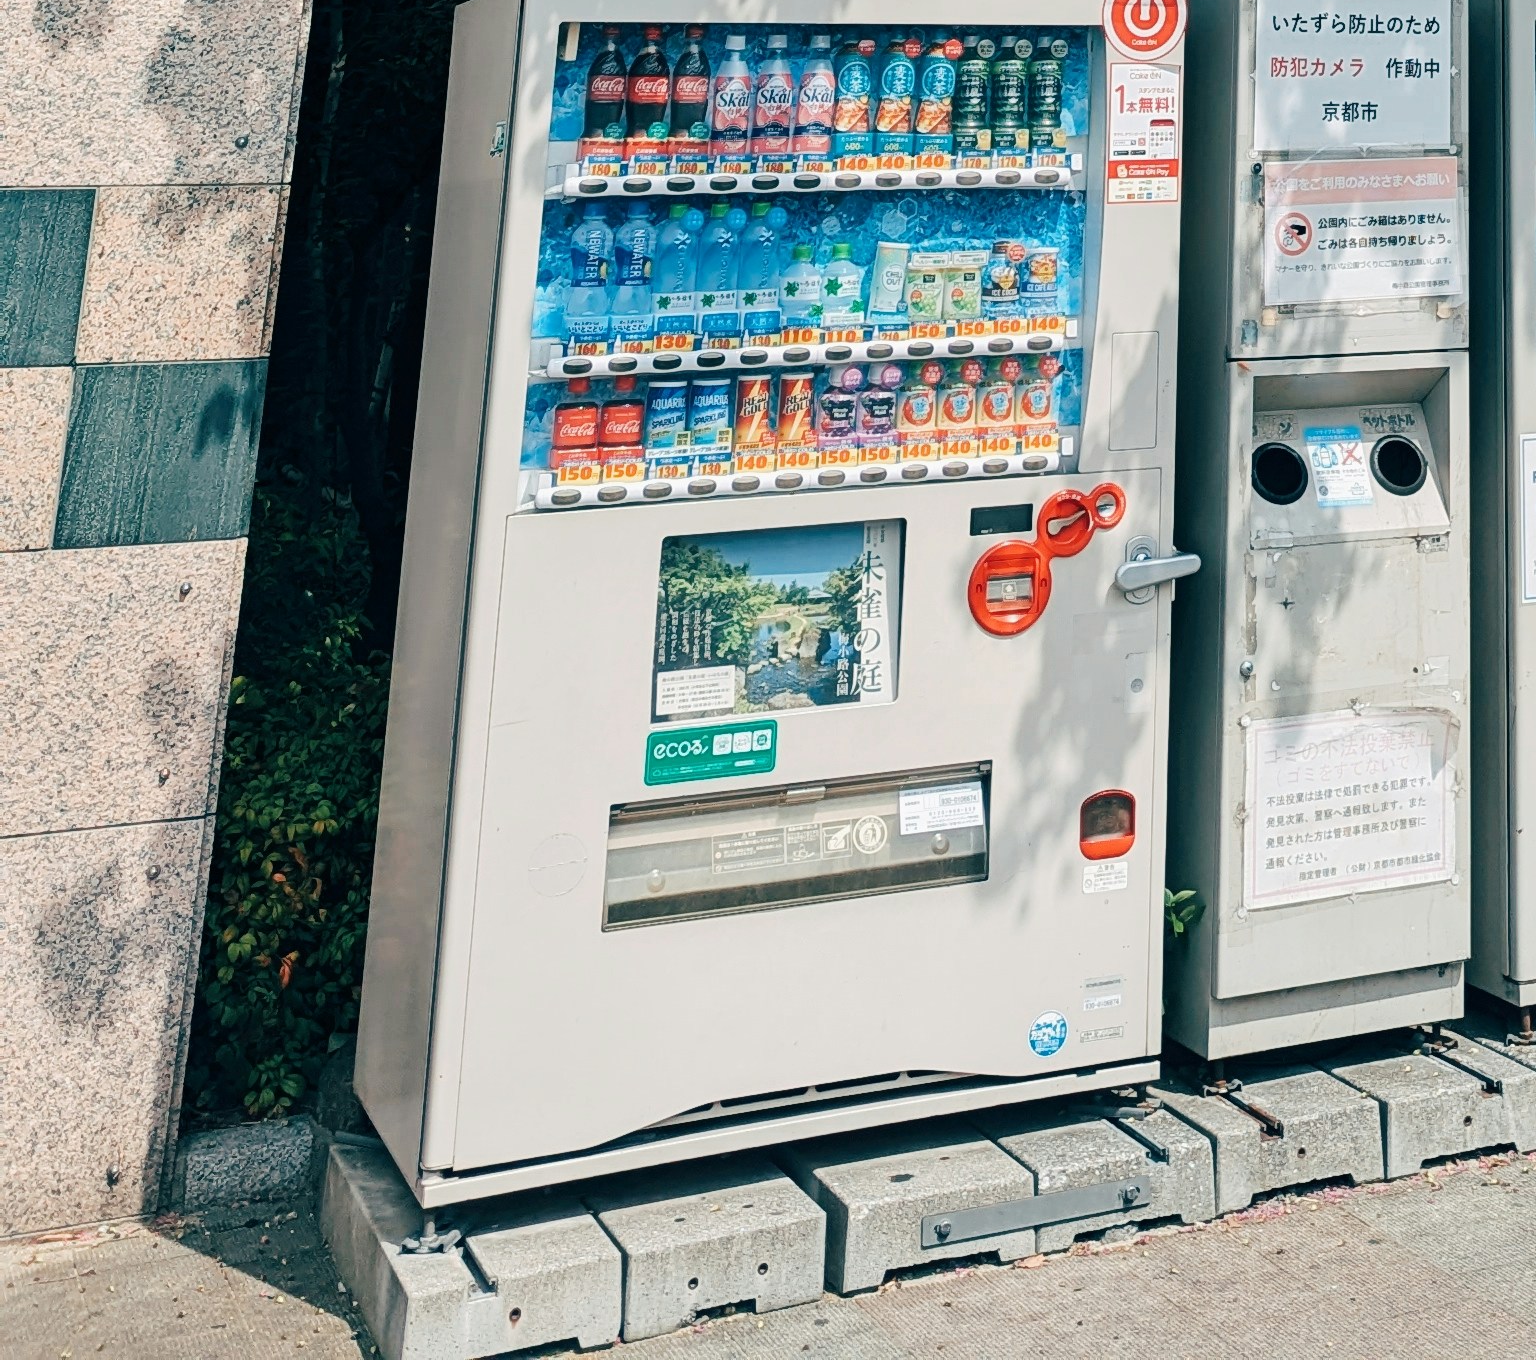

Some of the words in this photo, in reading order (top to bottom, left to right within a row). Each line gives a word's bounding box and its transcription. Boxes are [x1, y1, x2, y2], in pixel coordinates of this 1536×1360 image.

[1272, 14, 1441, 35] いたずら防止のため
[1270, 57, 1365, 77] 防犯カメラ
[1385, 57, 1441, 78] 作動中
[1321, 101, 1379, 122] 京都市
[1317, 213, 1452, 229] 公園内にごみ箱はありません。
[1317, 233, 1452, 250] ごみは各自持ち帰りましょう。
[849, 550, 884, 696] 朱雀の庭
[836, 632, 850, 697] 梅小路公園
[1264, 731, 1435, 765] ゴミの不法投棄禁止
[1266, 776, 1432, 807] 不法投棄は法律で処罰できる犯罪です。
[1265, 796, 1427, 828] 発見次第、警察へ通報致します。また
[1265, 817, 1427, 849] 発見された方は管理事務所及び警察に
